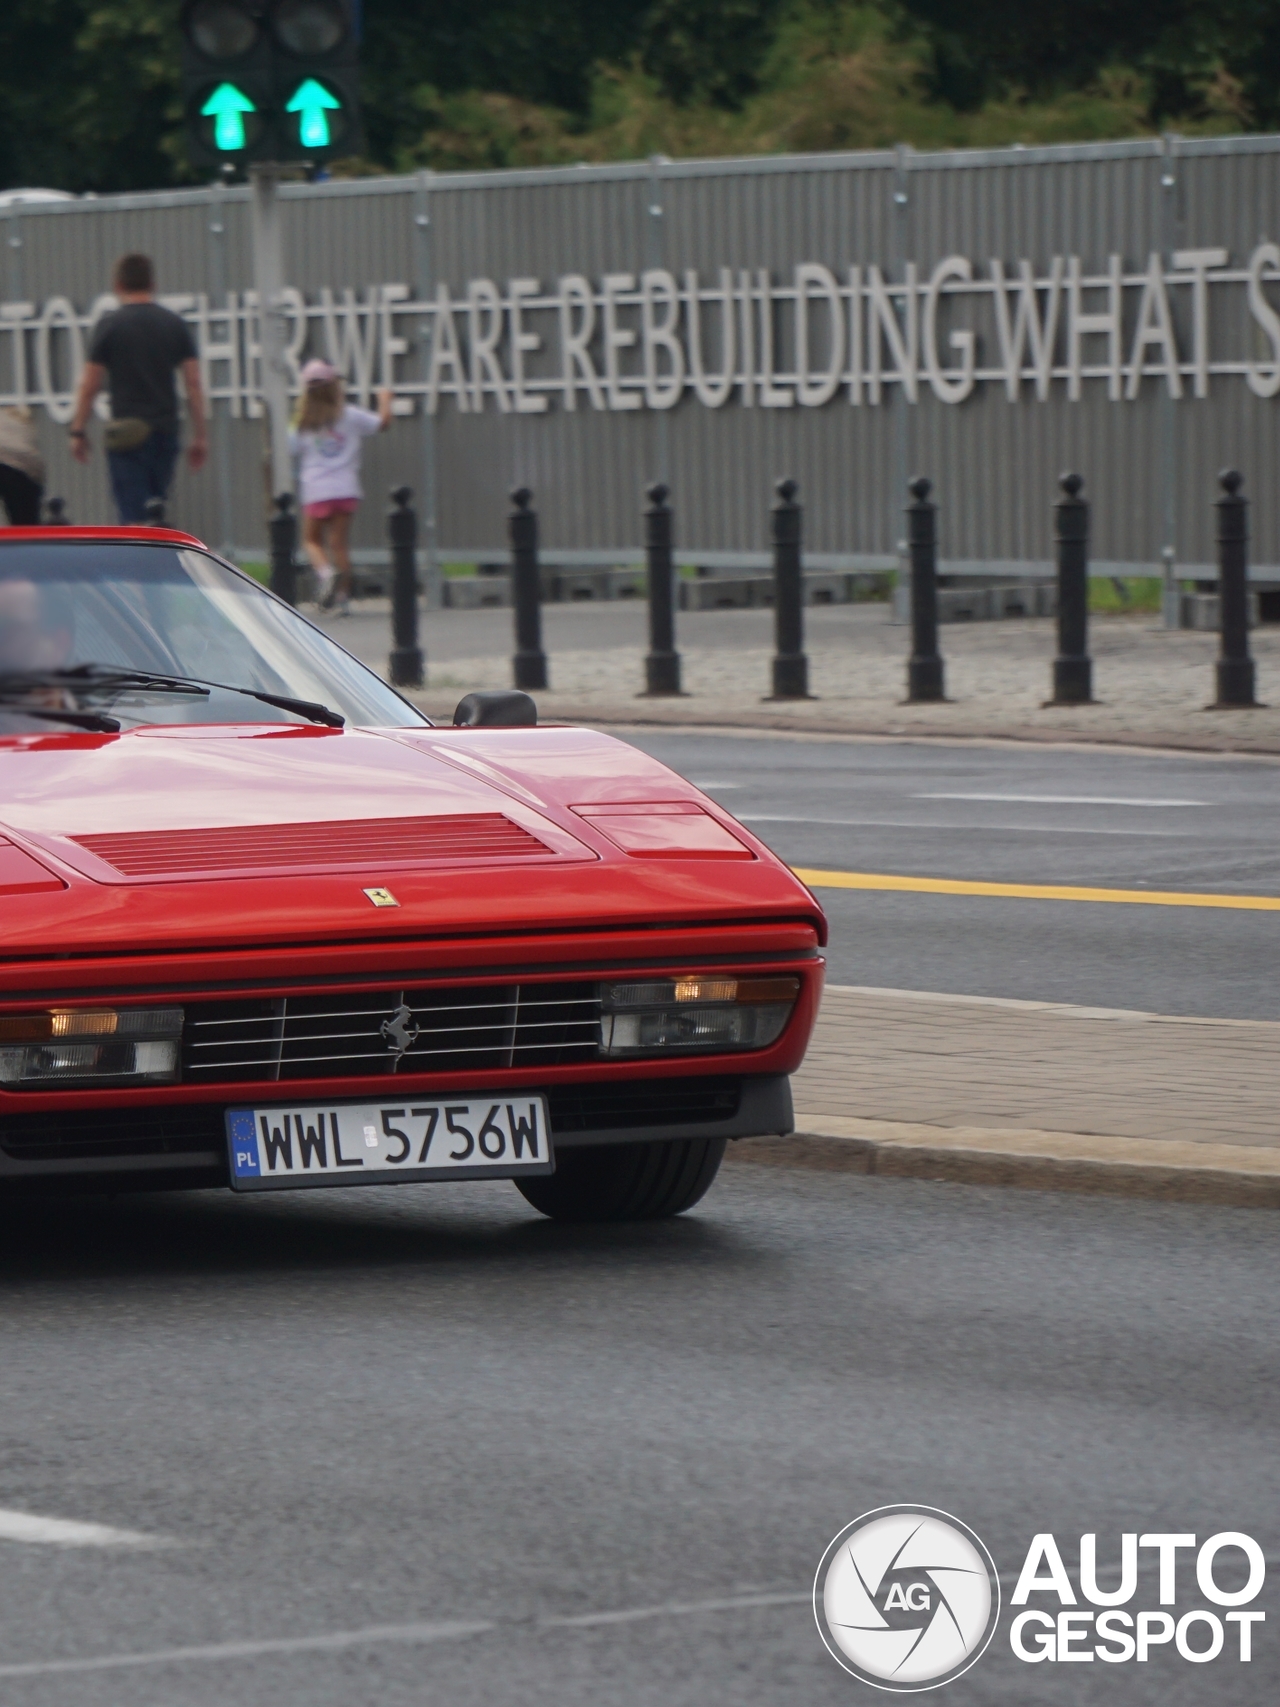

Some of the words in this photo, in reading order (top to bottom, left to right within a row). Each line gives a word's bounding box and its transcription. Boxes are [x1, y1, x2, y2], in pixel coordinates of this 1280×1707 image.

[321, 283, 414, 416] WE
[424, 277, 549, 415] ARE
[558, 255, 975, 412] REBUILDING
[991, 249, 1228, 403] WHAT
[236, 1151, 257, 1168] PL
[260, 1112, 364, 1170] WWL
[380, 1103, 539, 1164] 5756W
